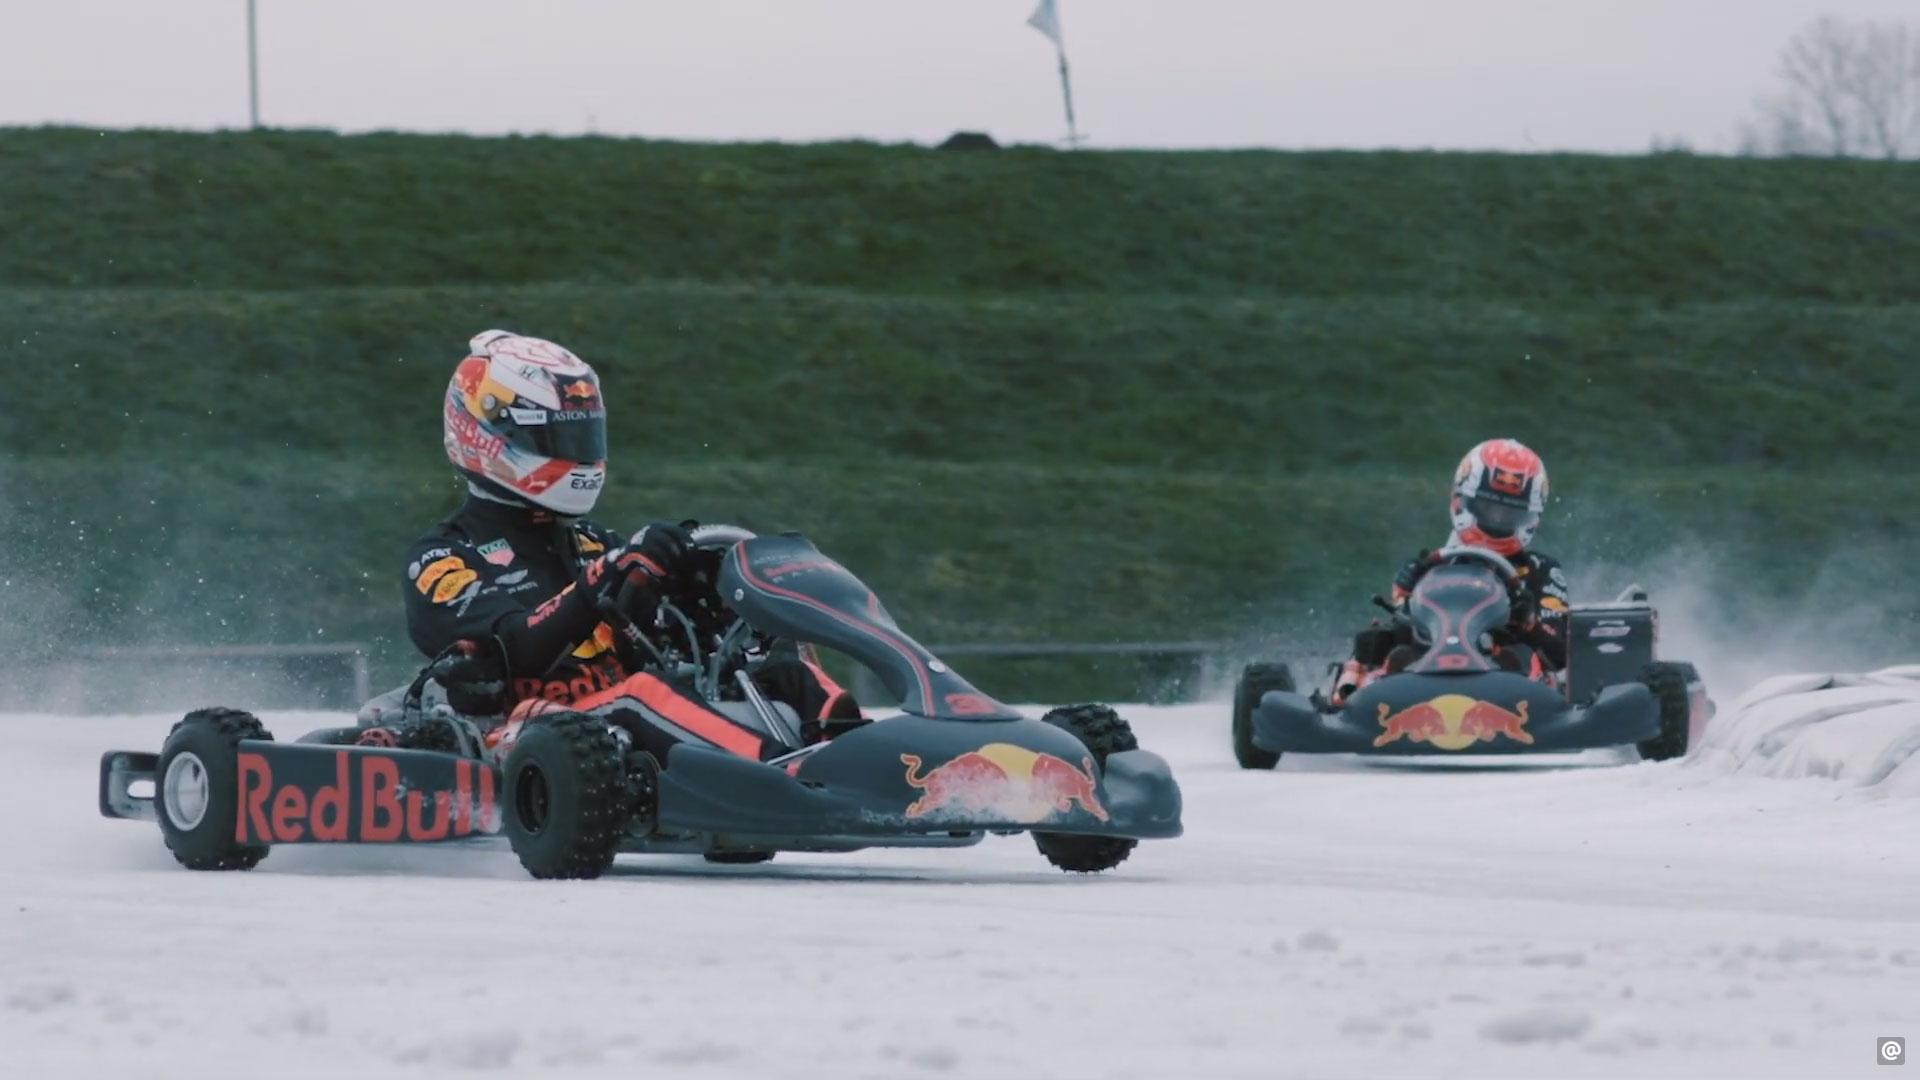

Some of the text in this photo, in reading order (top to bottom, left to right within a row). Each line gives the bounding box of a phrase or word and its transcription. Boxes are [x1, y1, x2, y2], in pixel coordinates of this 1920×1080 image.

[552, 410, 587, 421] ASTON
[421, 547, 452, 565] AT&T
[235, 751, 496, 844] Red Bull
